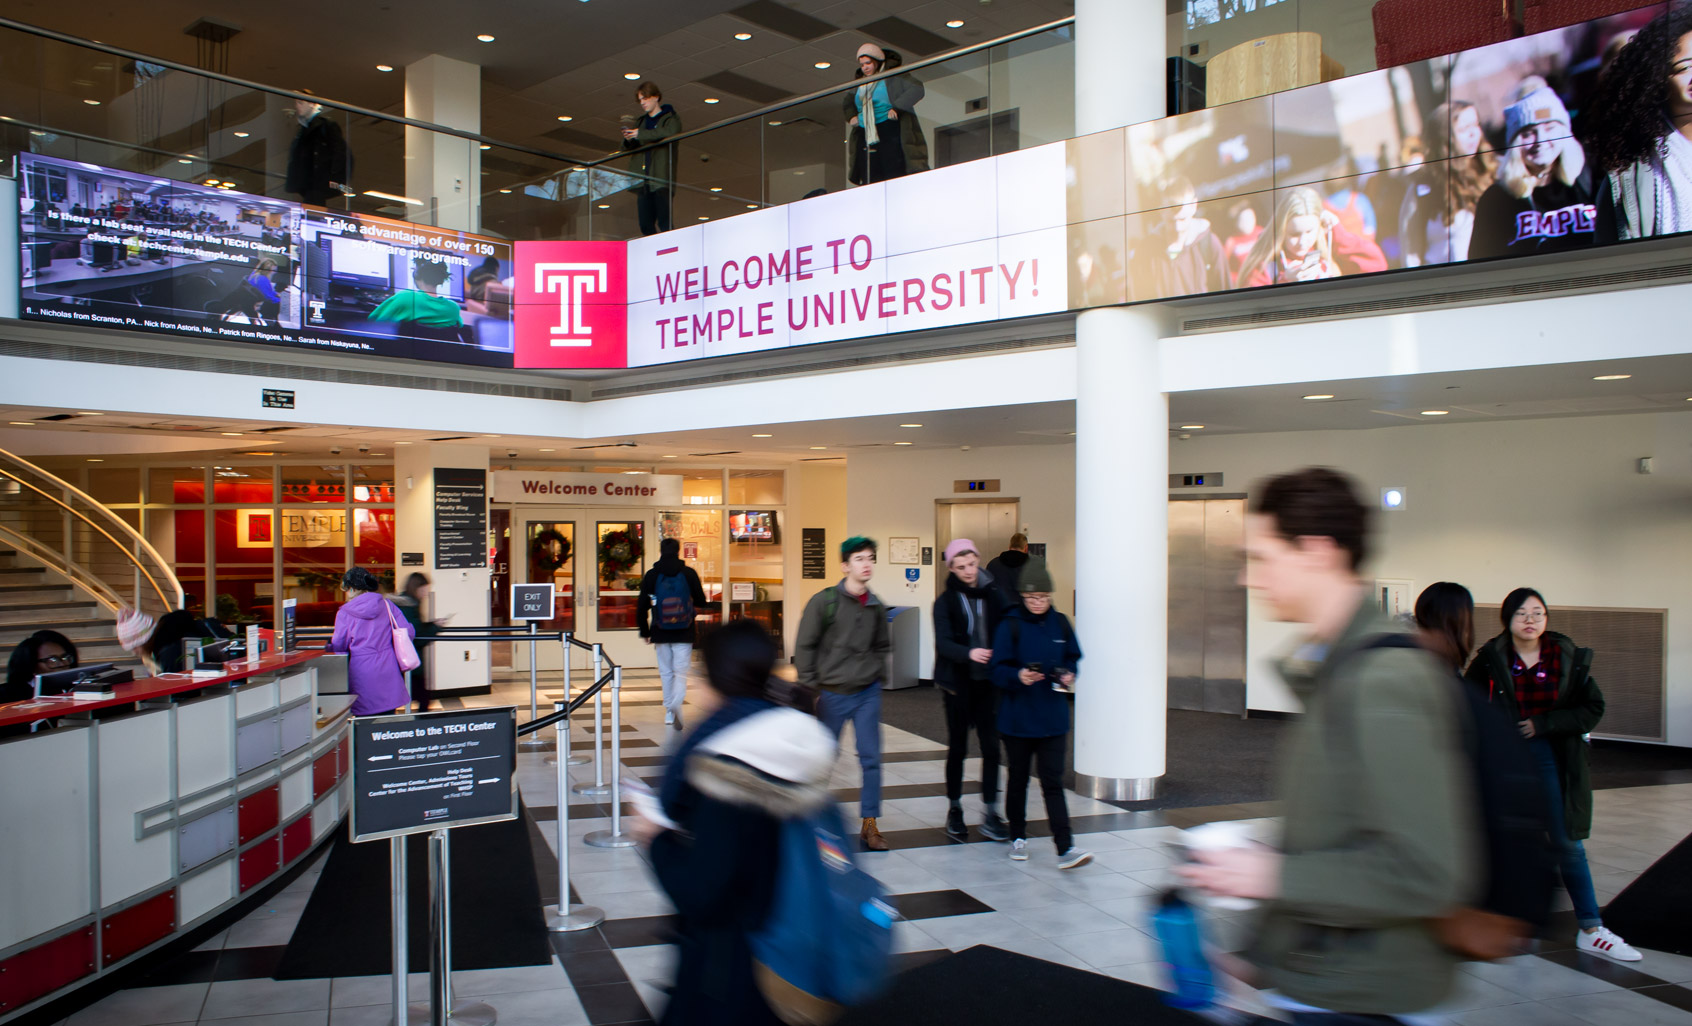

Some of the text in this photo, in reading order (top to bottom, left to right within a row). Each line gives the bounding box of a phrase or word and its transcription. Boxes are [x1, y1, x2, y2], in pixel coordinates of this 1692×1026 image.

[48, 210, 59, 219] Is
[61, 212, 90, 224] there
[102, 218, 119, 229] lab
[121, 223, 144, 233] seat
[146, 226, 193, 241] available
[194, 232, 204, 242] in
[205, 234, 222, 245] the
[222, 237, 249, 249] TECH
[250, 241, 287, 255] Center?
[324, 217, 495, 256] Take advantage of over 150
[1515, 203, 1597, 240] EMPL
[87, 231, 250, 263] check at: techcenter.temple.edu
[352, 239, 472, 267] software programs.
[656, 234, 872, 305] WELCOME TO
[656, 258, 1039, 349] TEMPLE UNIVERSITY!
[40, 308, 72, 319] Nicholas
[73, 312, 90, 320] from
[91, 314, 125, 325] Scranton,
[126, 317, 143, 326] PA...
[144, 319, 159, 328] Nick
[160, 321, 176, 329] from
[177, 323, 202, 333] Astoria,
[203, 326, 218, 335] Ne...
[219, 328, 241, 337] Patrick
[241, 330, 255, 338] from
[256, 332, 282, 342] Ringoes,
[283, 334, 297, 343] Ne...
[298, 336, 316, 345] Sarah
[316, 338, 330, 346] from
[361, 343, 375, 351] Ne...
[522, 480, 657, 497] Welcome Center
[371, 721, 496, 741] Welcome to the TECH Center
[398, 746, 428, 755] Computer
